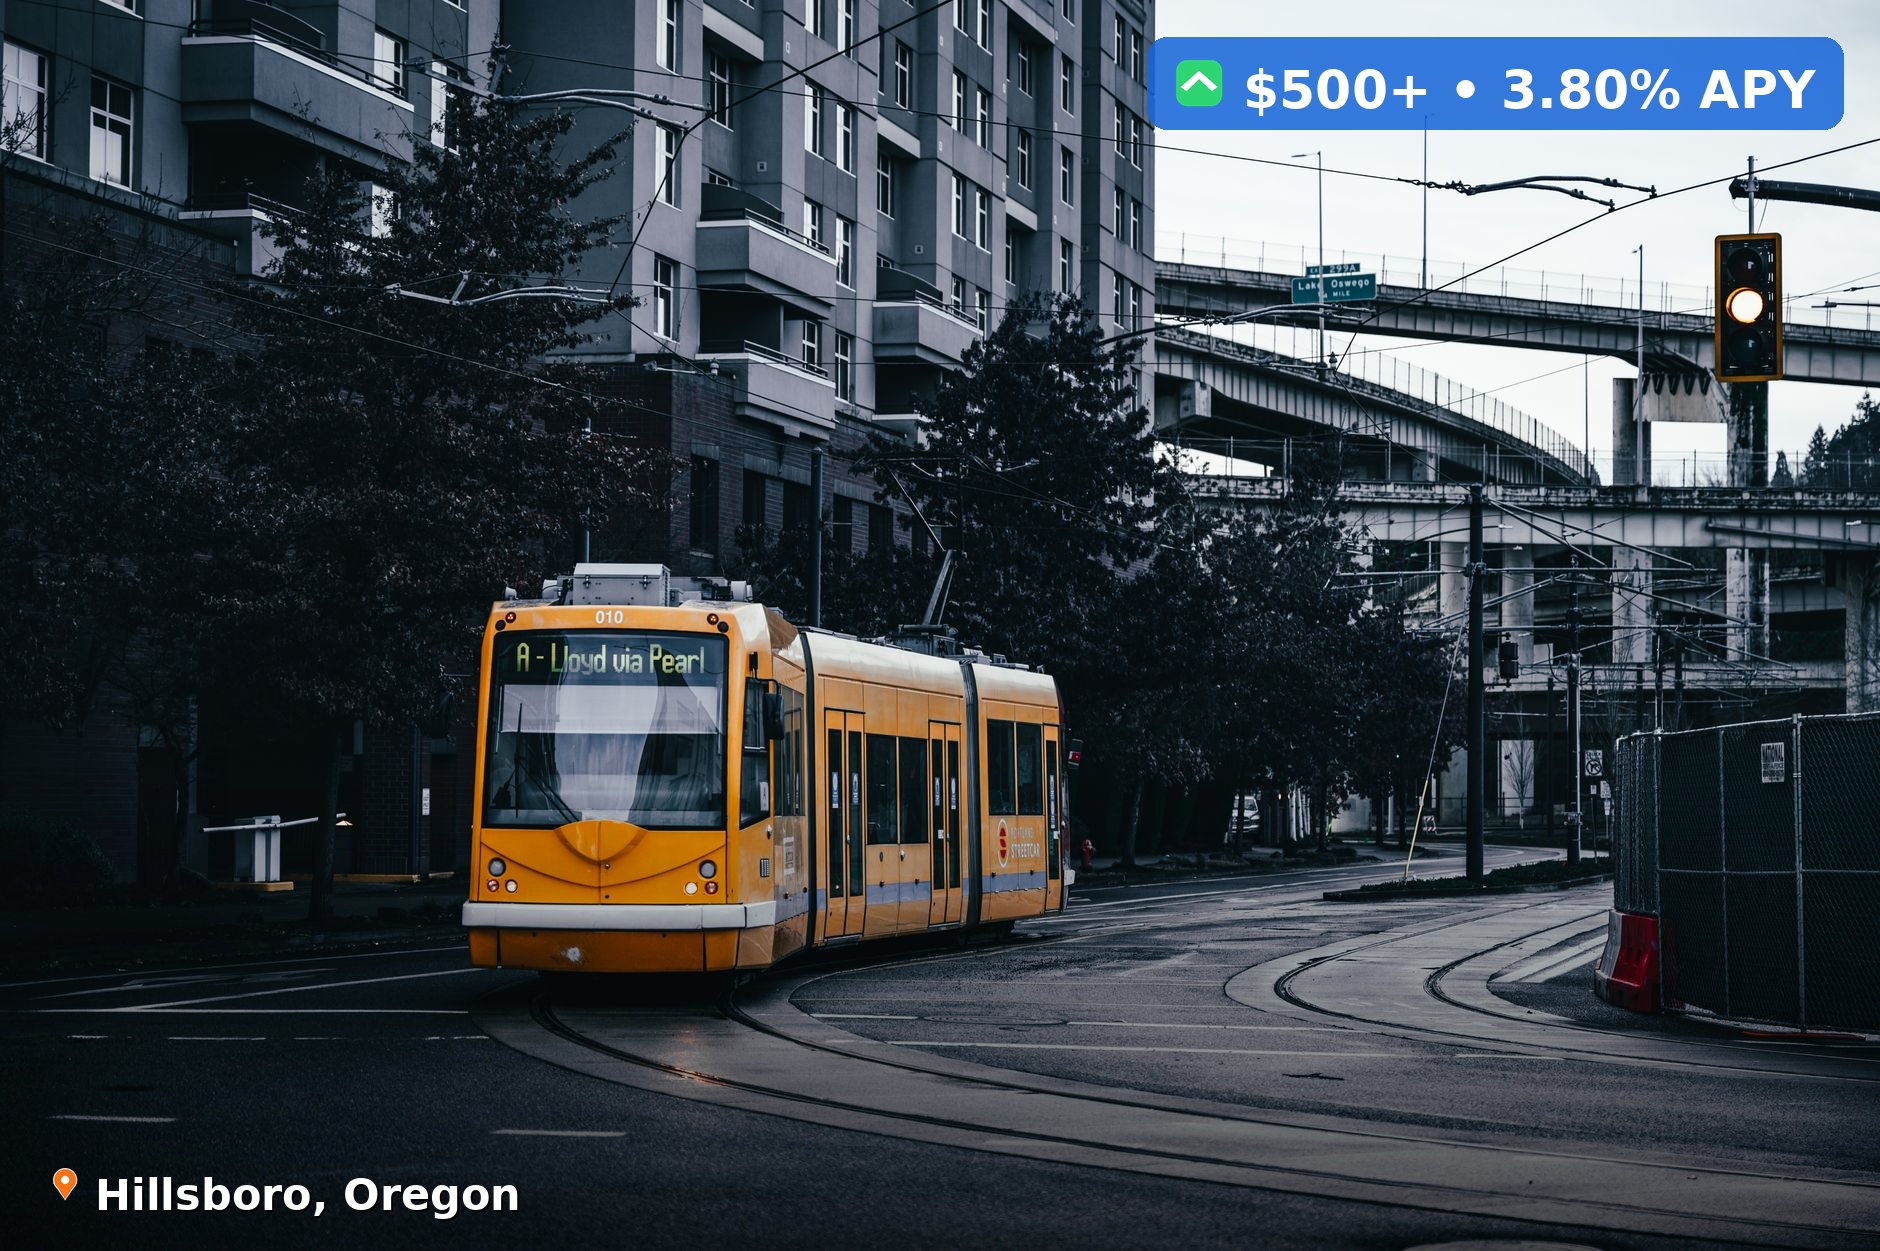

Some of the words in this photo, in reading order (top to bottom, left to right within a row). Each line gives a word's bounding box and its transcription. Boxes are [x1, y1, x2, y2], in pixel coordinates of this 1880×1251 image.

[1329, 264, 1356, 273] 299A
[1331, 279, 1370, 289] Oswego
[595, 610, 624, 624] 010
[516, 642, 530, 673] A
[551, 642, 606, 675] Lloyd
[613, 647, 643, 674] via
[650, 643, 705, 674] Pearl
[1011, 843, 1040, 858] STREETCAR
